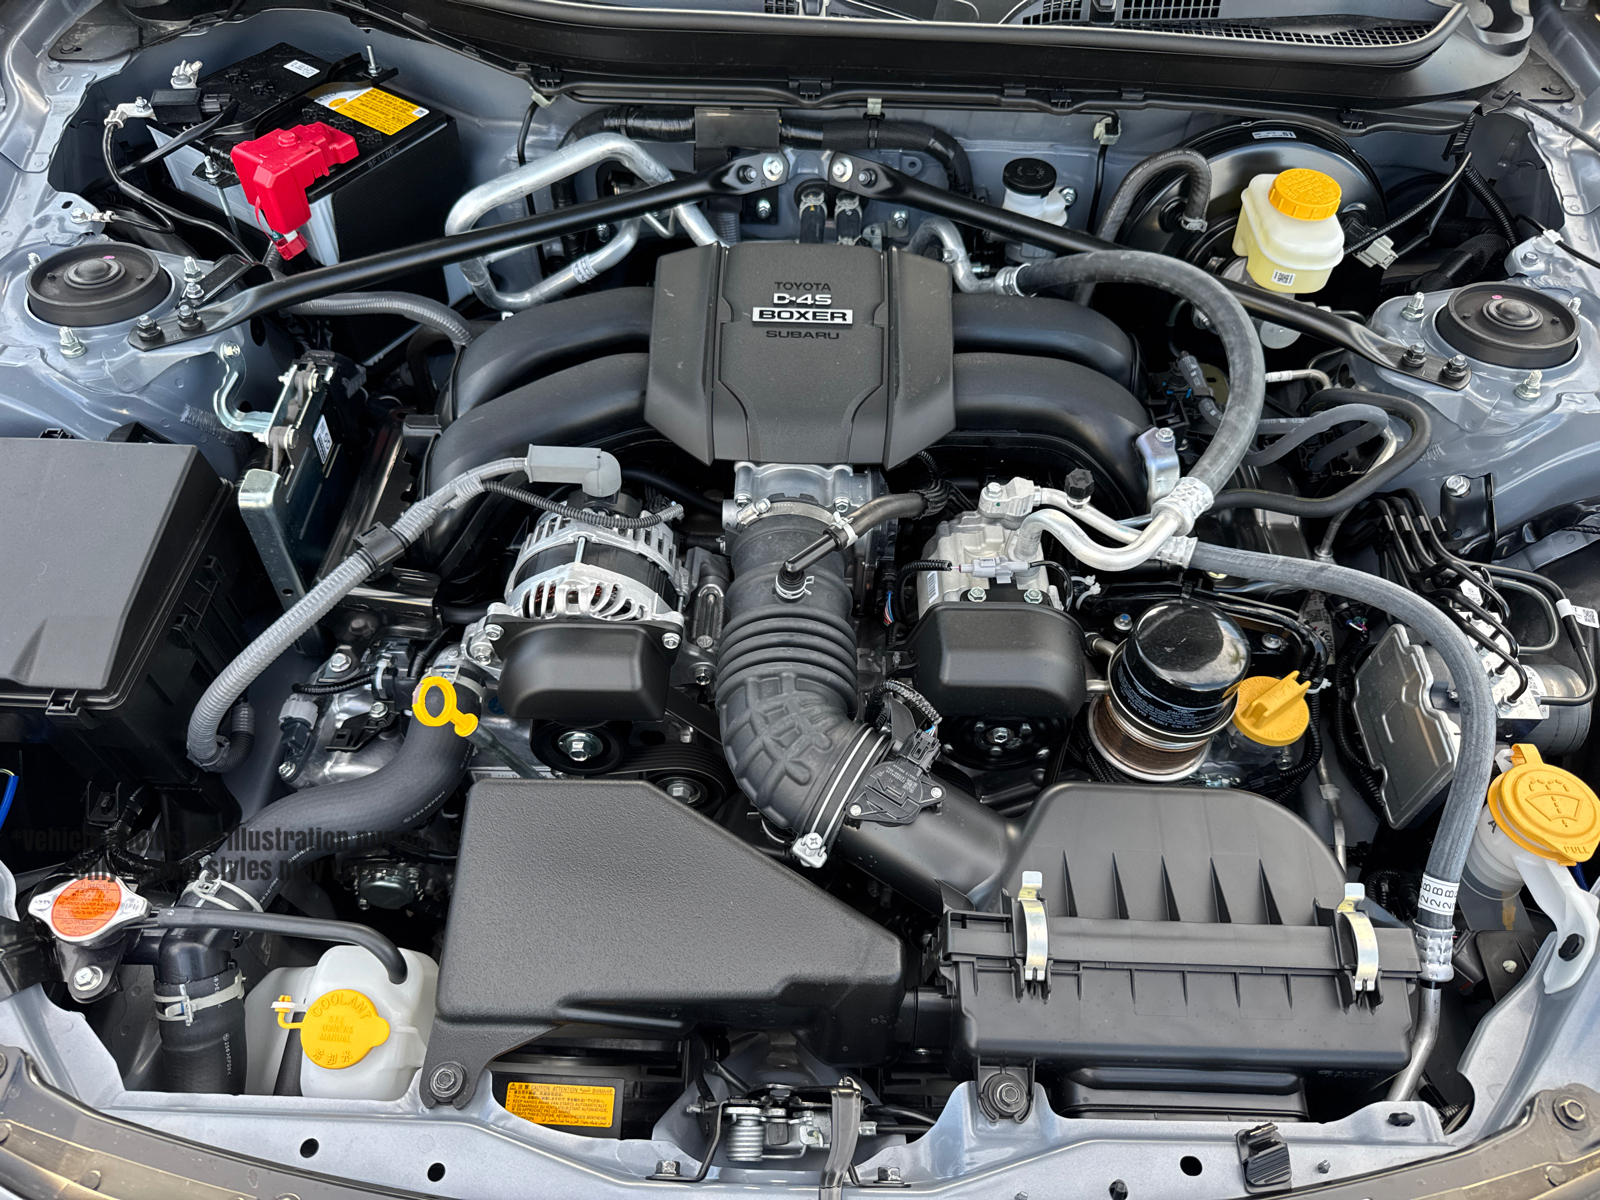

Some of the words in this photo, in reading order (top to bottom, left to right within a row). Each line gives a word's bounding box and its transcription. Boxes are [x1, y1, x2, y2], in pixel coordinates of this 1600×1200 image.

[774, 281, 832, 292] TOYOTA
[758, 309, 848, 322] BOXER
[765, 330, 840, 340] SUBARU
[1563, 845, 1591, 854] PULL
[311, 992, 373, 1020] COOLANT
[318, 1032, 352, 1044] MANUAL
